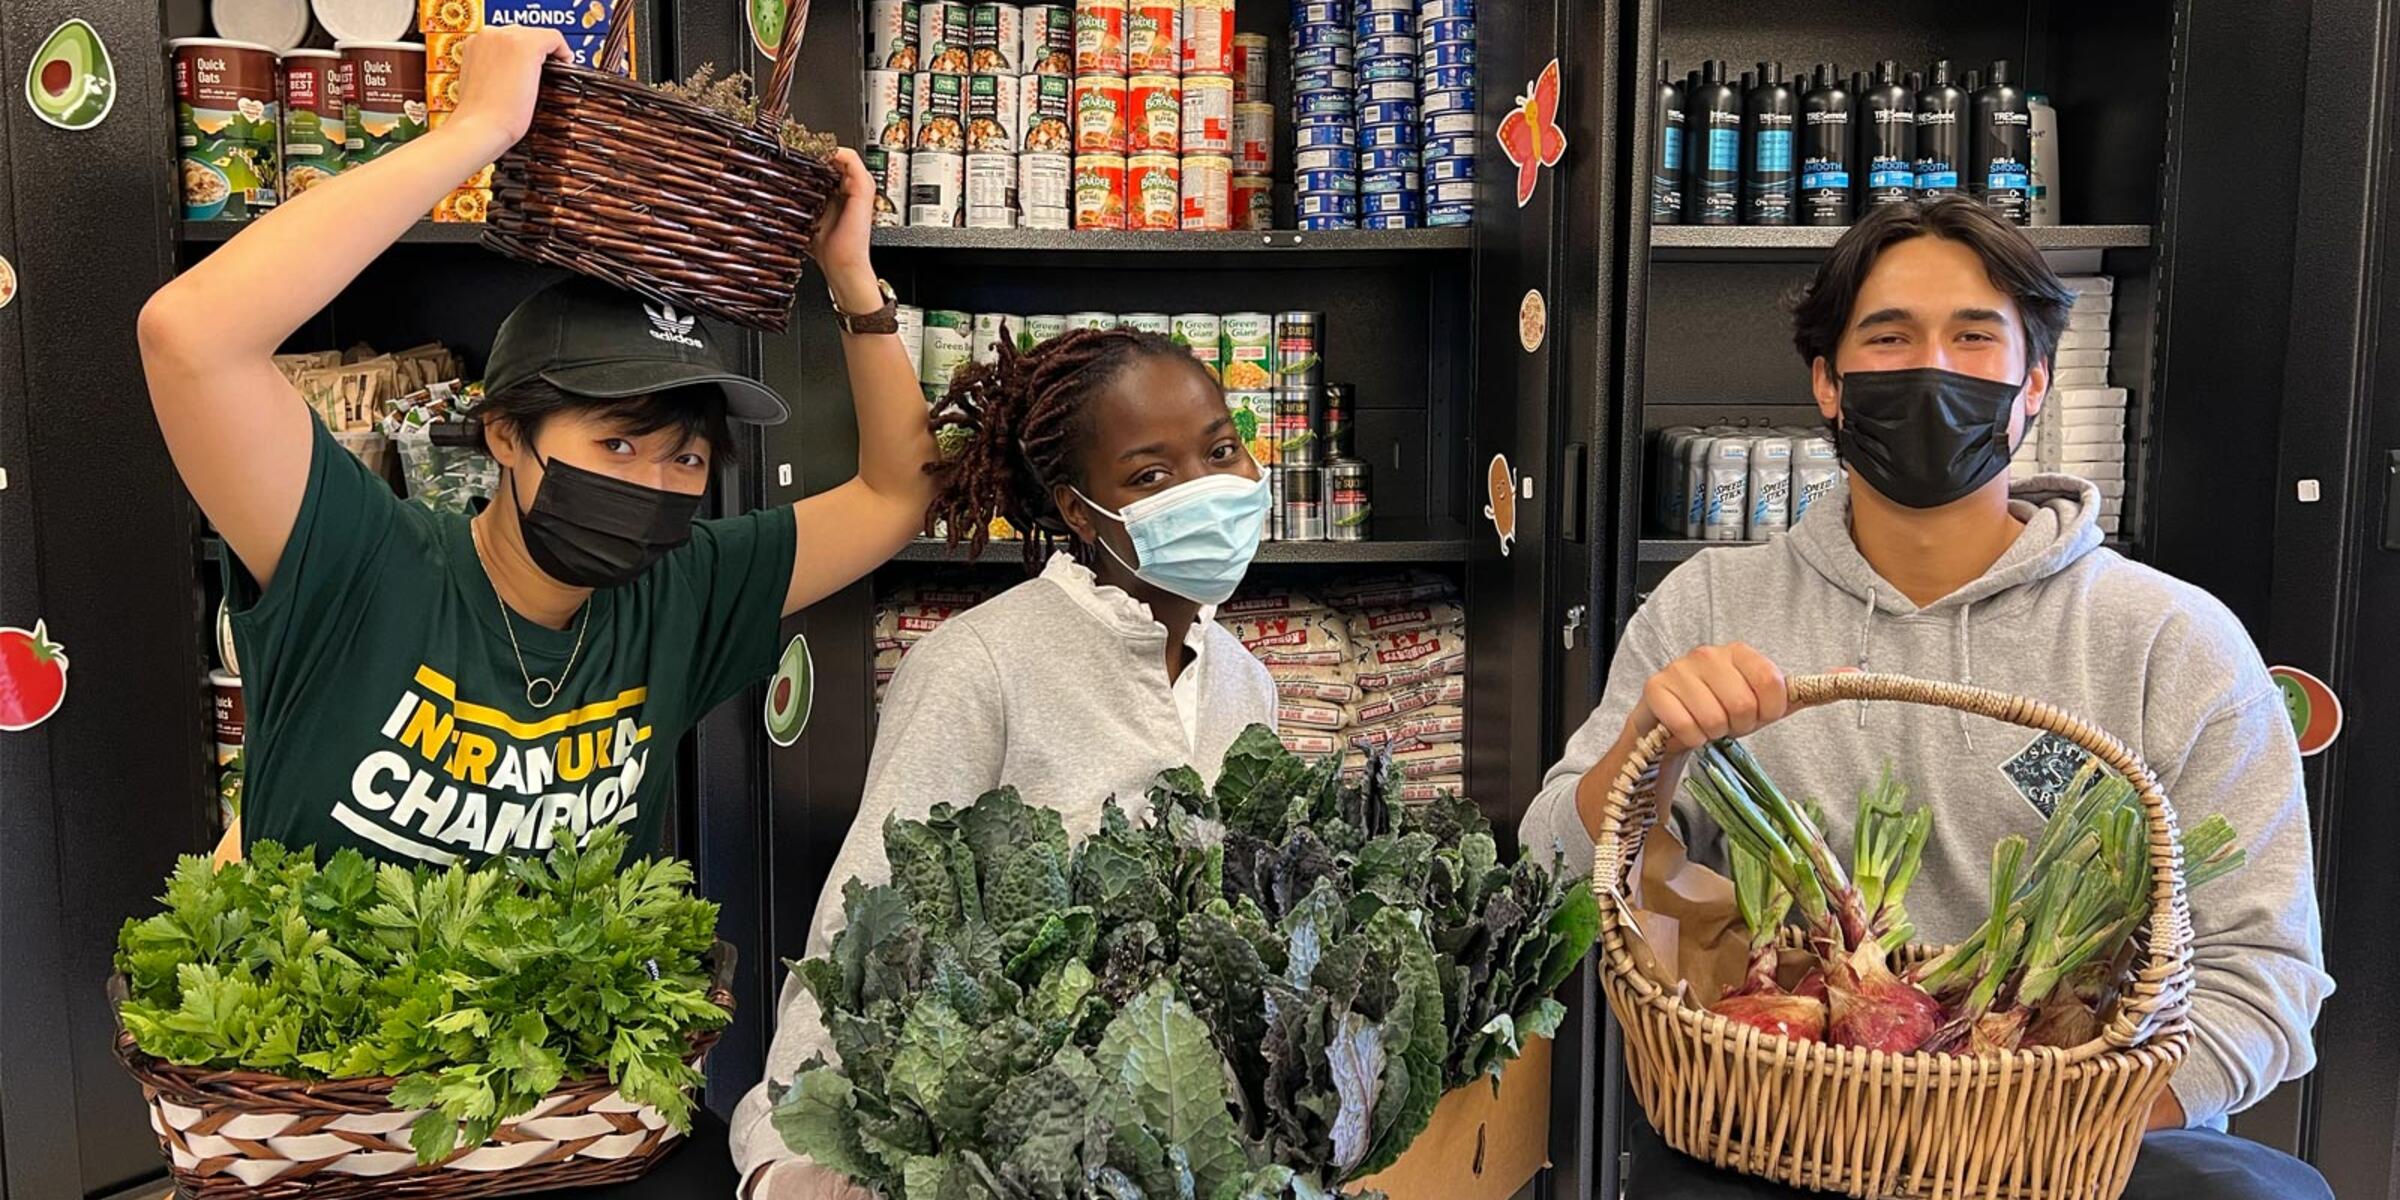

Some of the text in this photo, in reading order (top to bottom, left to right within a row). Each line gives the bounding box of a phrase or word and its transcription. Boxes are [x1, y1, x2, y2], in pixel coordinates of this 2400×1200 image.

[492, 10, 576, 25] ALMONDS
[197, 58, 227, 71] Quick
[363, 60, 392, 73] Quick
[198, 72, 221, 83] Oats
[365, 74, 387, 87] Oats
[289, 81, 313, 90] BEST
[1871, 161, 1910, 171] SMOOTH
[1031, 320, 1060, 330] Green
[1184, 320, 1214, 330] Green
[1228, 319, 1258, 329] Green
[649, 329, 704, 349] adidas
[1188, 329, 1214, 338] Giant
[1231, 329, 1259, 338] Giant
[935, 340, 965, 351] Green
[1716, 479, 1745, 494] SPEED
[1763, 479, 1788, 494] SPEED
[1804, 479, 1833, 494] SPEED
[1719, 490, 1743, 503] STICK
[1766, 490, 1788, 503] STICK
[1382, 642, 1435, 663] ROBERTS
[214, 695, 234, 709] uick
[214, 709, 230, 721] ats
